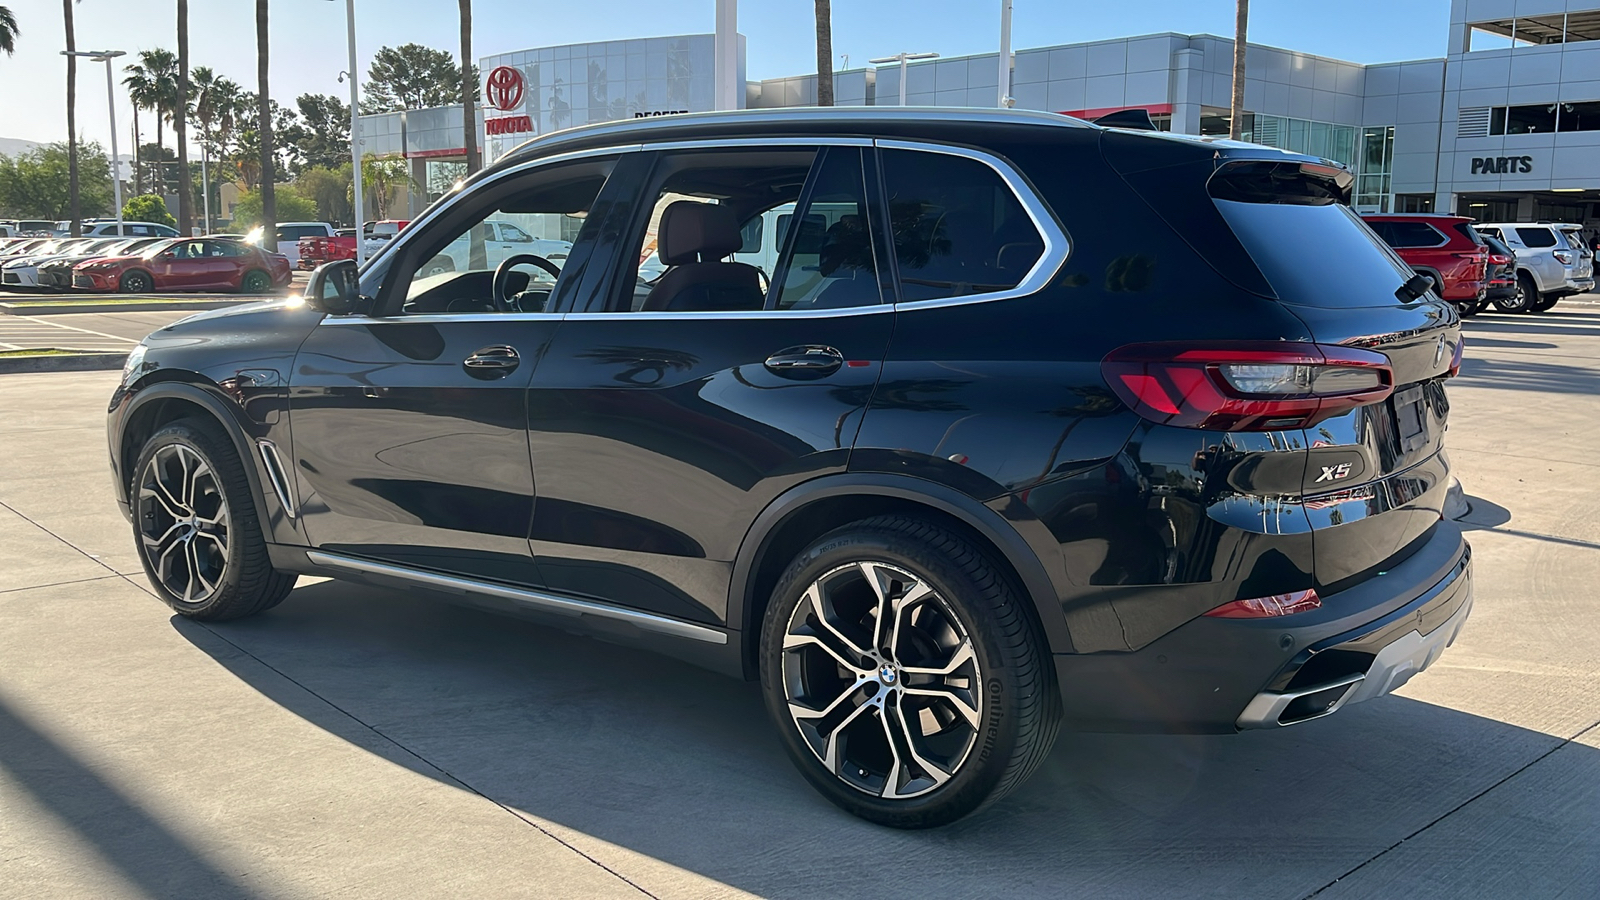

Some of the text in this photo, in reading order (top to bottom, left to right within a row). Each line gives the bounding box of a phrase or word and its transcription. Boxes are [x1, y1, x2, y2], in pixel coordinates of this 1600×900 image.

[485, 116, 533, 136] TOYOTA
[1471, 156, 1533, 175] PARTS
[1314, 462, 1353, 483] X5
[979, 678, 1004, 763] Continental
